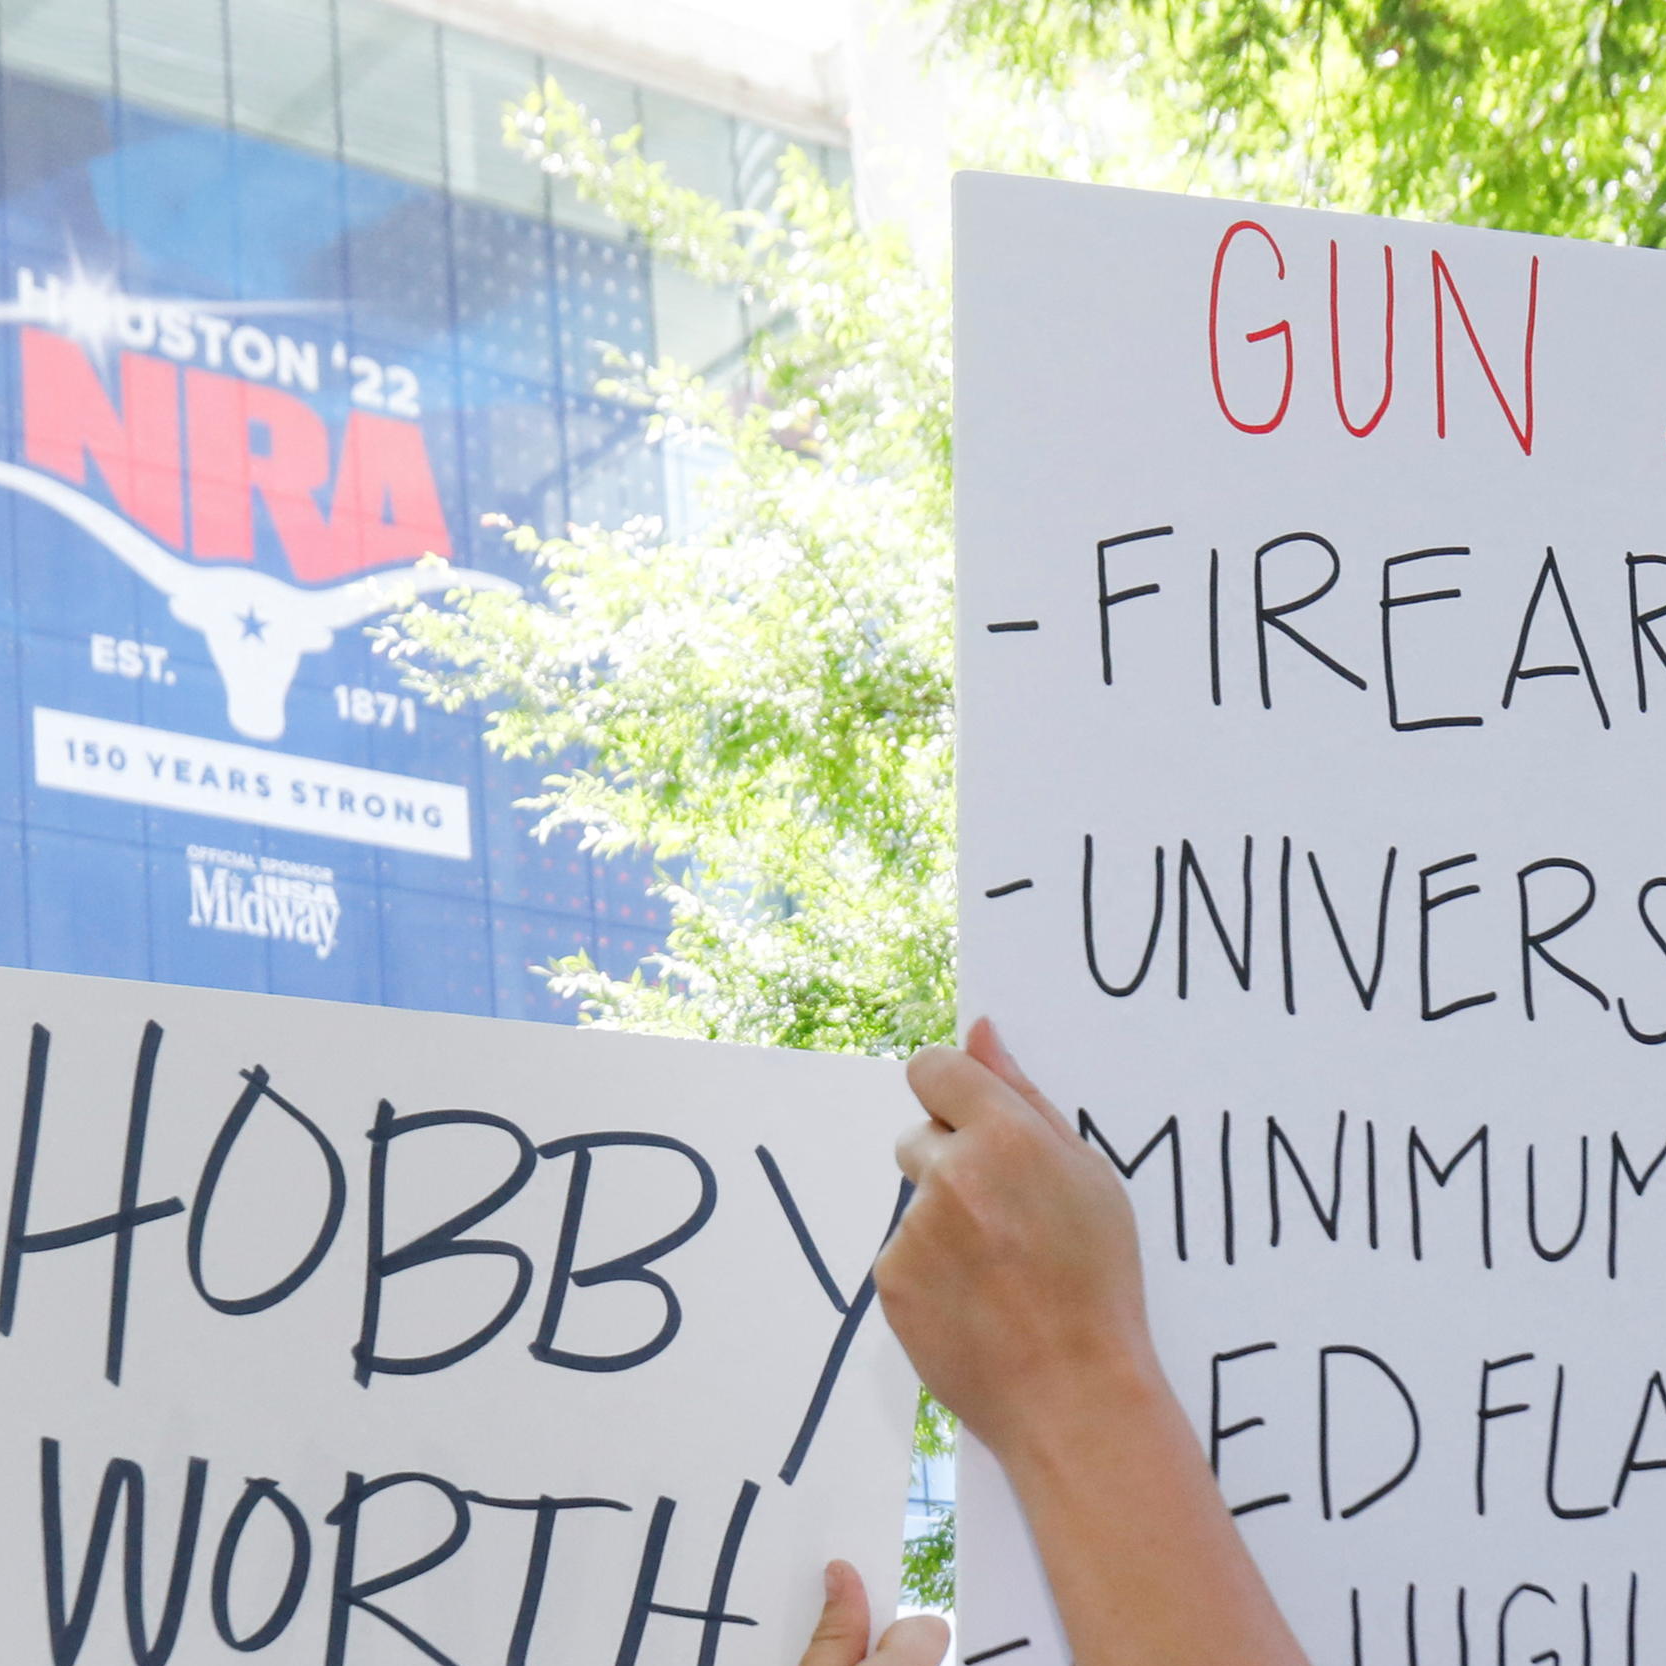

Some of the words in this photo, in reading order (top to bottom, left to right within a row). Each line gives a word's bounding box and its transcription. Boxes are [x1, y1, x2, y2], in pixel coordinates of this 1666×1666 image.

[18, 267, 319, 393] HUSTON
[1209, 220, 1539, 456] GUN
[21, 326, 454, 583] NRA
[90, 633, 177, 686] EST.
[333, 682, 417, 733] 1871
[64, 737, 127, 774] 150
[145, 751, 272, 799] YEARS
[291, 779, 445, 832] STRONG
[189, 864, 341, 961] Midway
[1210, 1342, 1421, 1521] ED
